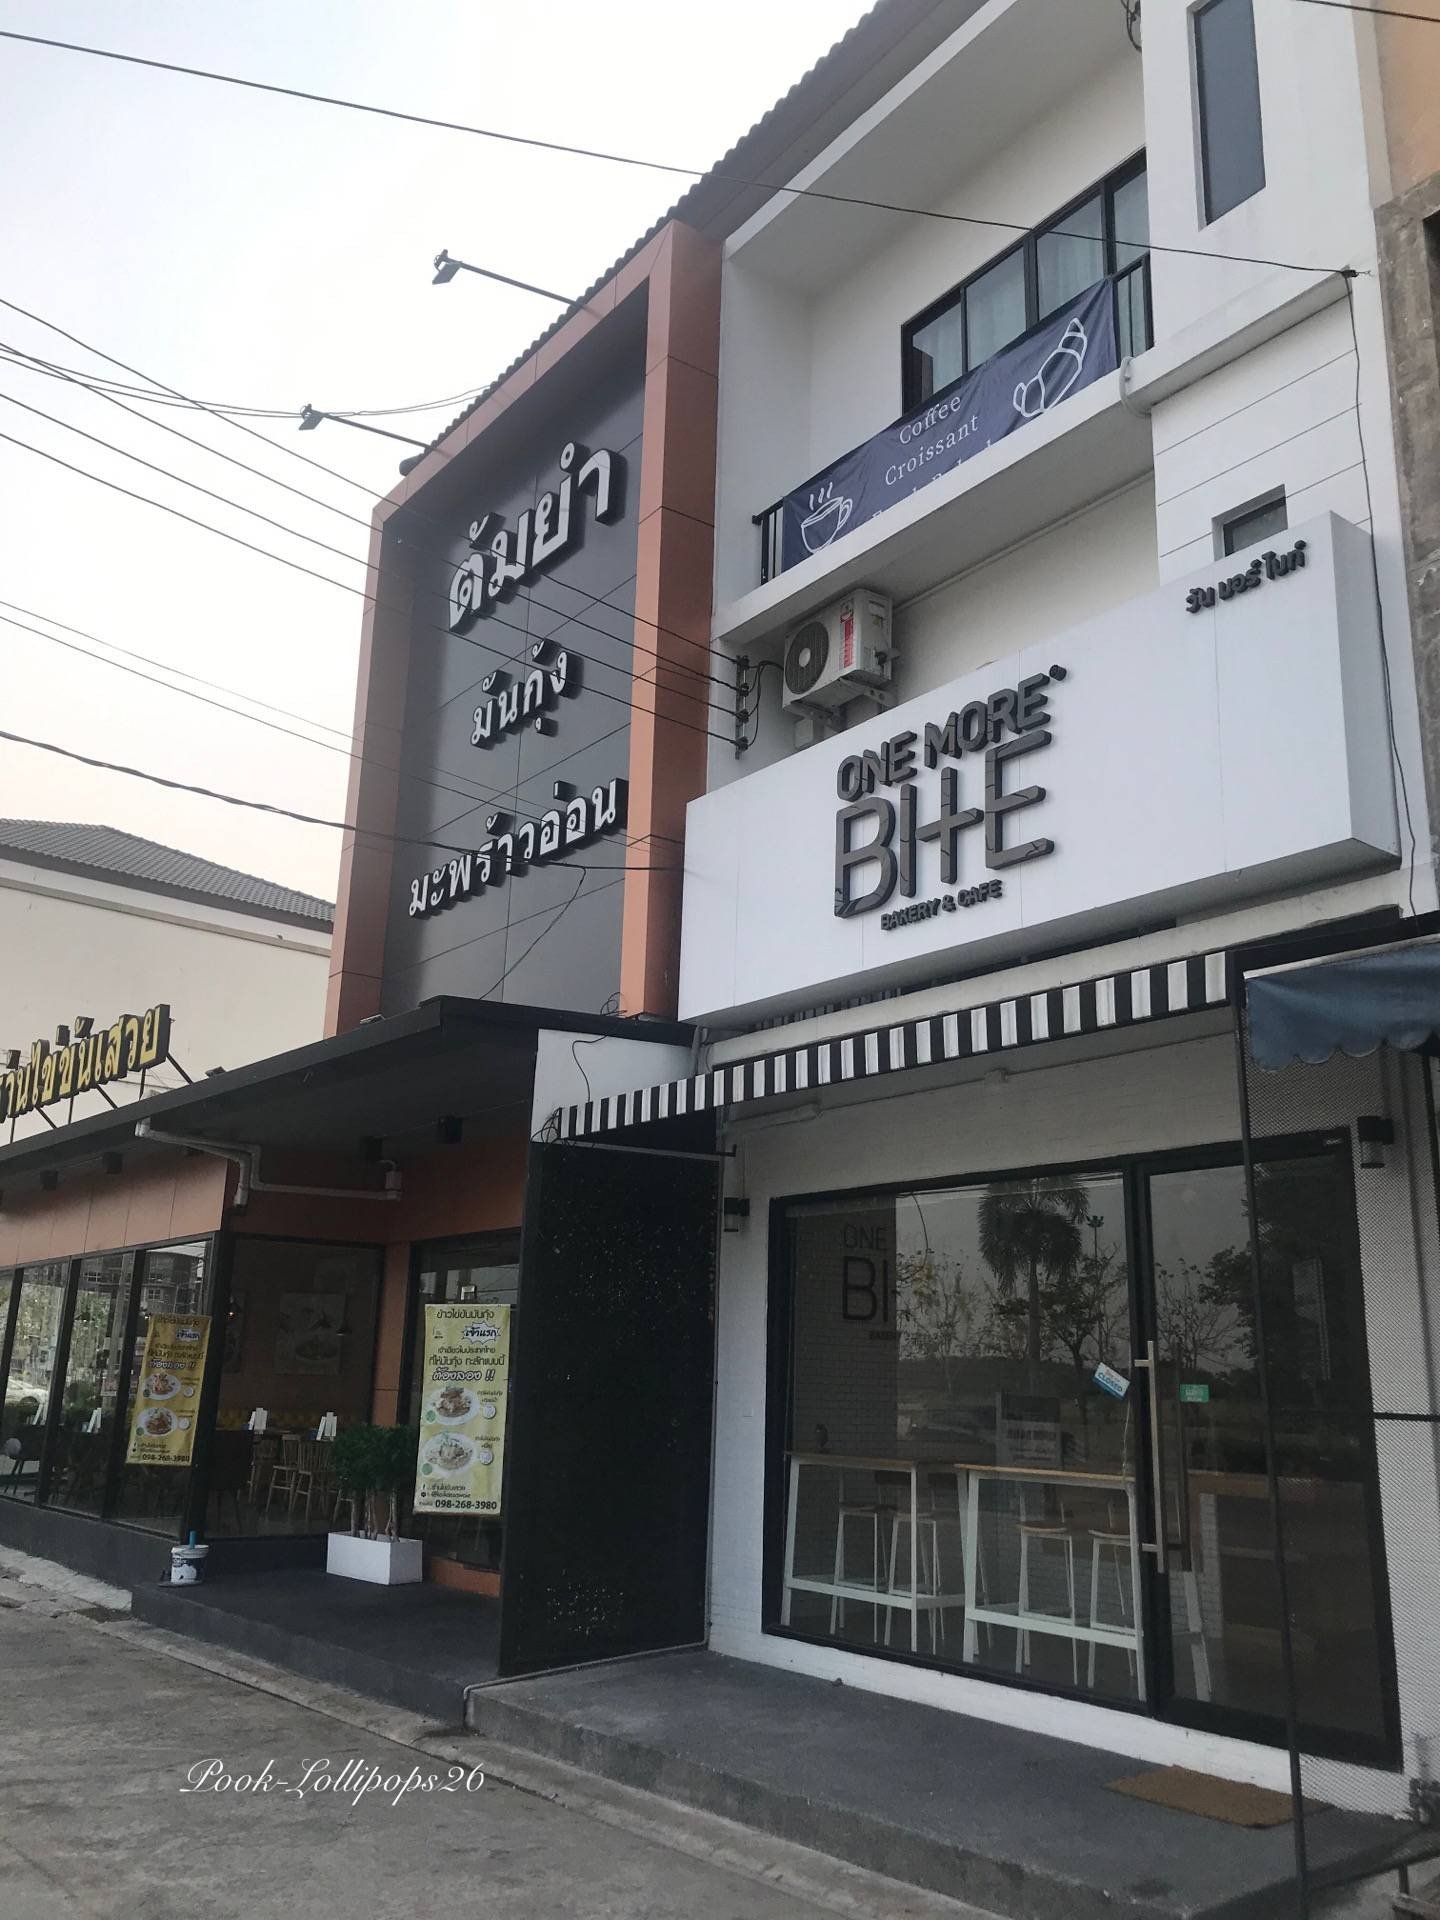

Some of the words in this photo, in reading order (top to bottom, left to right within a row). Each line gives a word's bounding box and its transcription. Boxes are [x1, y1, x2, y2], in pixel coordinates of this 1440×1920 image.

[884, 414, 979, 486] Croissant
[899, 396, 962, 445] Coffee
[449, 441, 624, 632] ต้มยำ
[471, 637, 573, 746] มันกุ้ง
[836, 731, 917, 801] ONE
[924, 673, 1051, 769] MORE
[409, 778, 624, 917] มะพร้าวอ่อน
[834, 729, 1055, 918] BITE
[880, 896, 941, 930] BAKERY
[941, 894, 957, 912] &
[958, 879, 1002, 907] CAFE
[0, 1004, 168, 1122] ้านไข่ข้นเสวย
[843, 1223, 888, 1251] ONE
[1098, 1372, 1123, 1392] CLOSED
[435, 1500, 498, 1510] 098-268-3980
